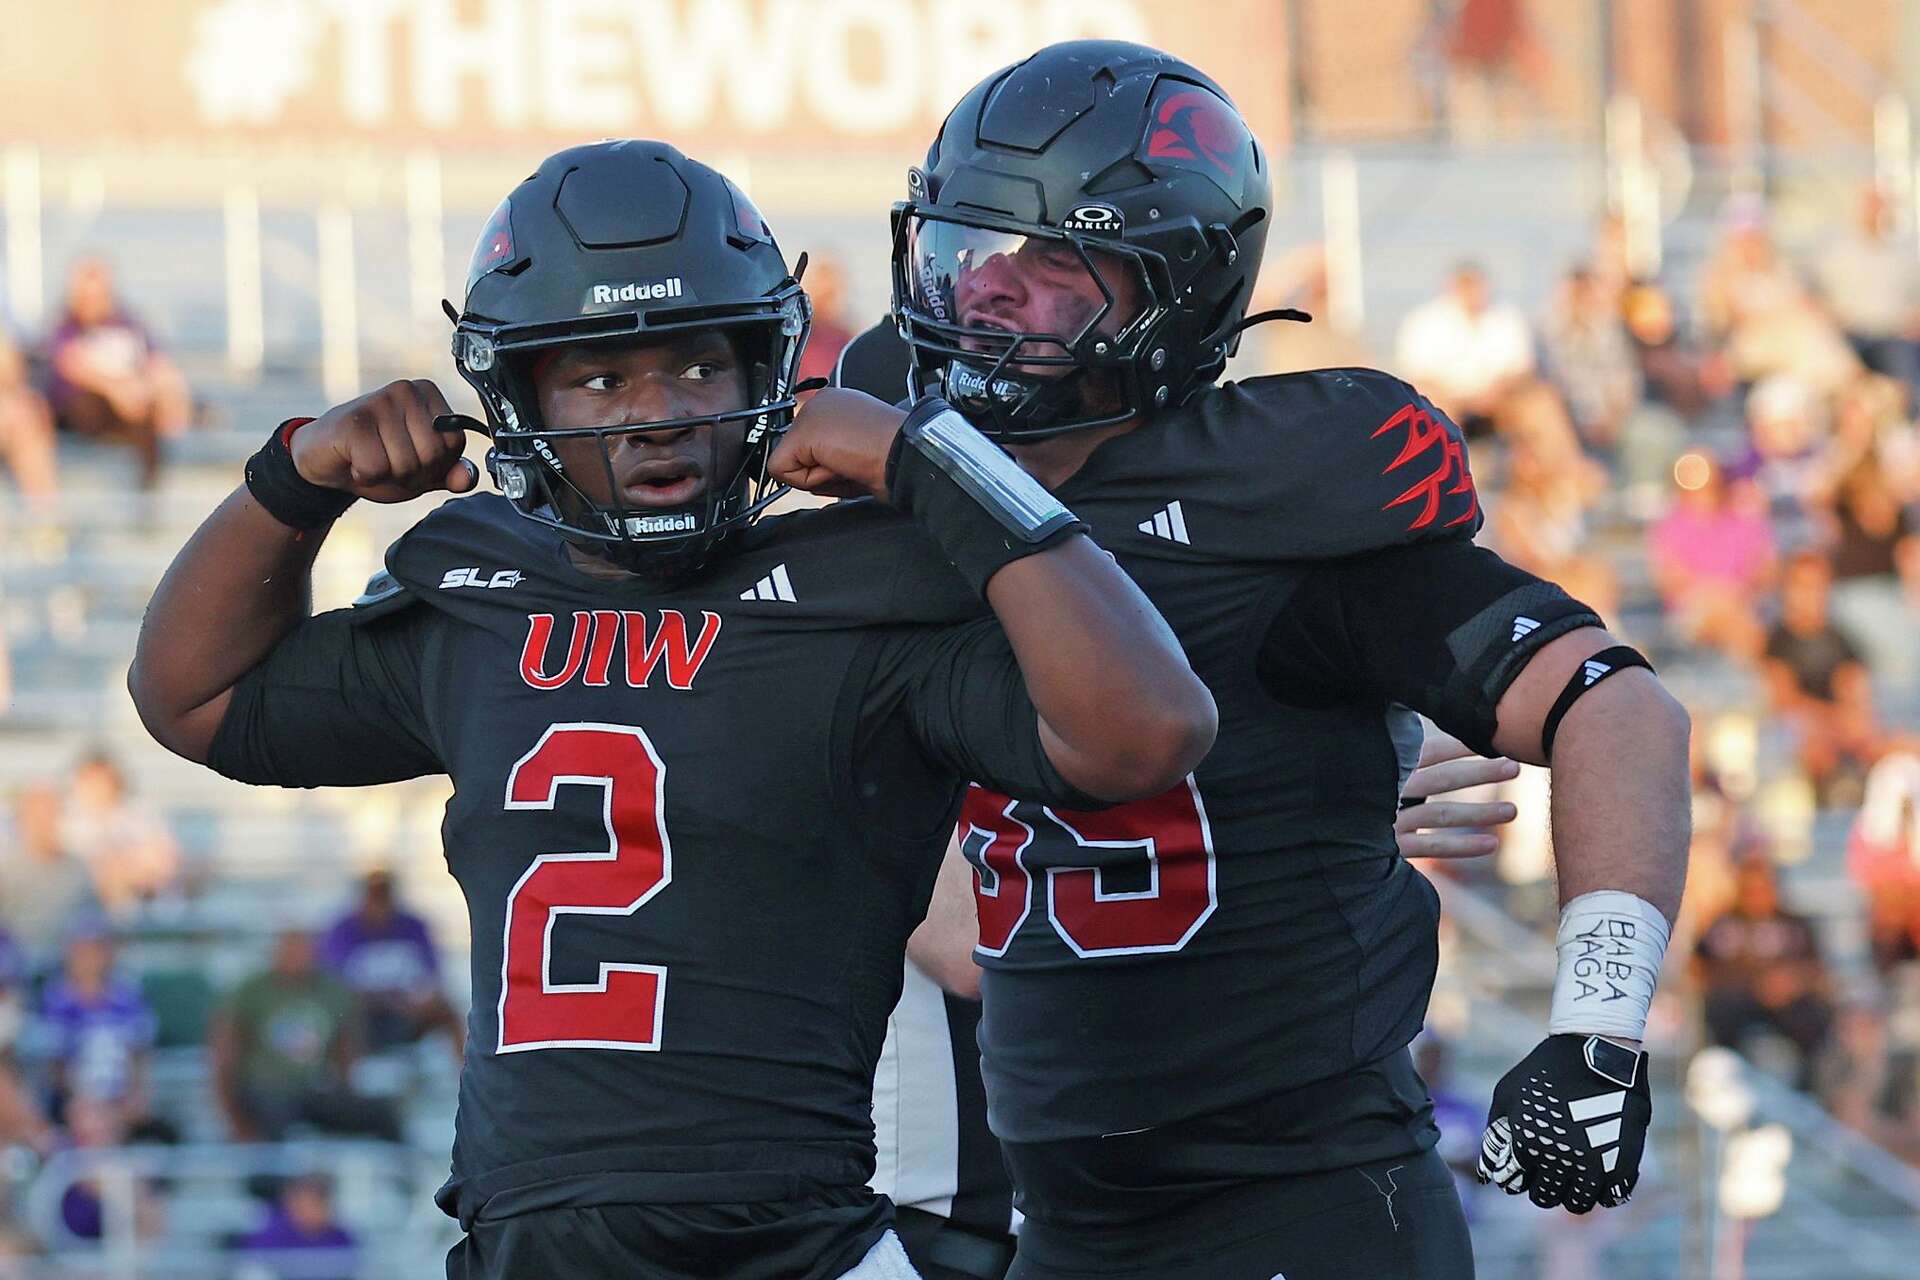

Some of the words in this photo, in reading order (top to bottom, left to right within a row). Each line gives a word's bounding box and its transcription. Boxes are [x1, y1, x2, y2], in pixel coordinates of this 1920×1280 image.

[182, 0, 1150, 136] #THEWOR
[1064, 220, 1121, 230] OAKLEY
[593, 277, 682, 304] Riddell
[746, 377, 787, 444] Ridll
[635, 515, 696, 534] Riddell
[518, 609, 722, 691] UIW
[496, 721, 673, 1054] 2
[1573, 919, 1604, 1002] YAGA
[1601, 919, 1636, 1002] BABA
